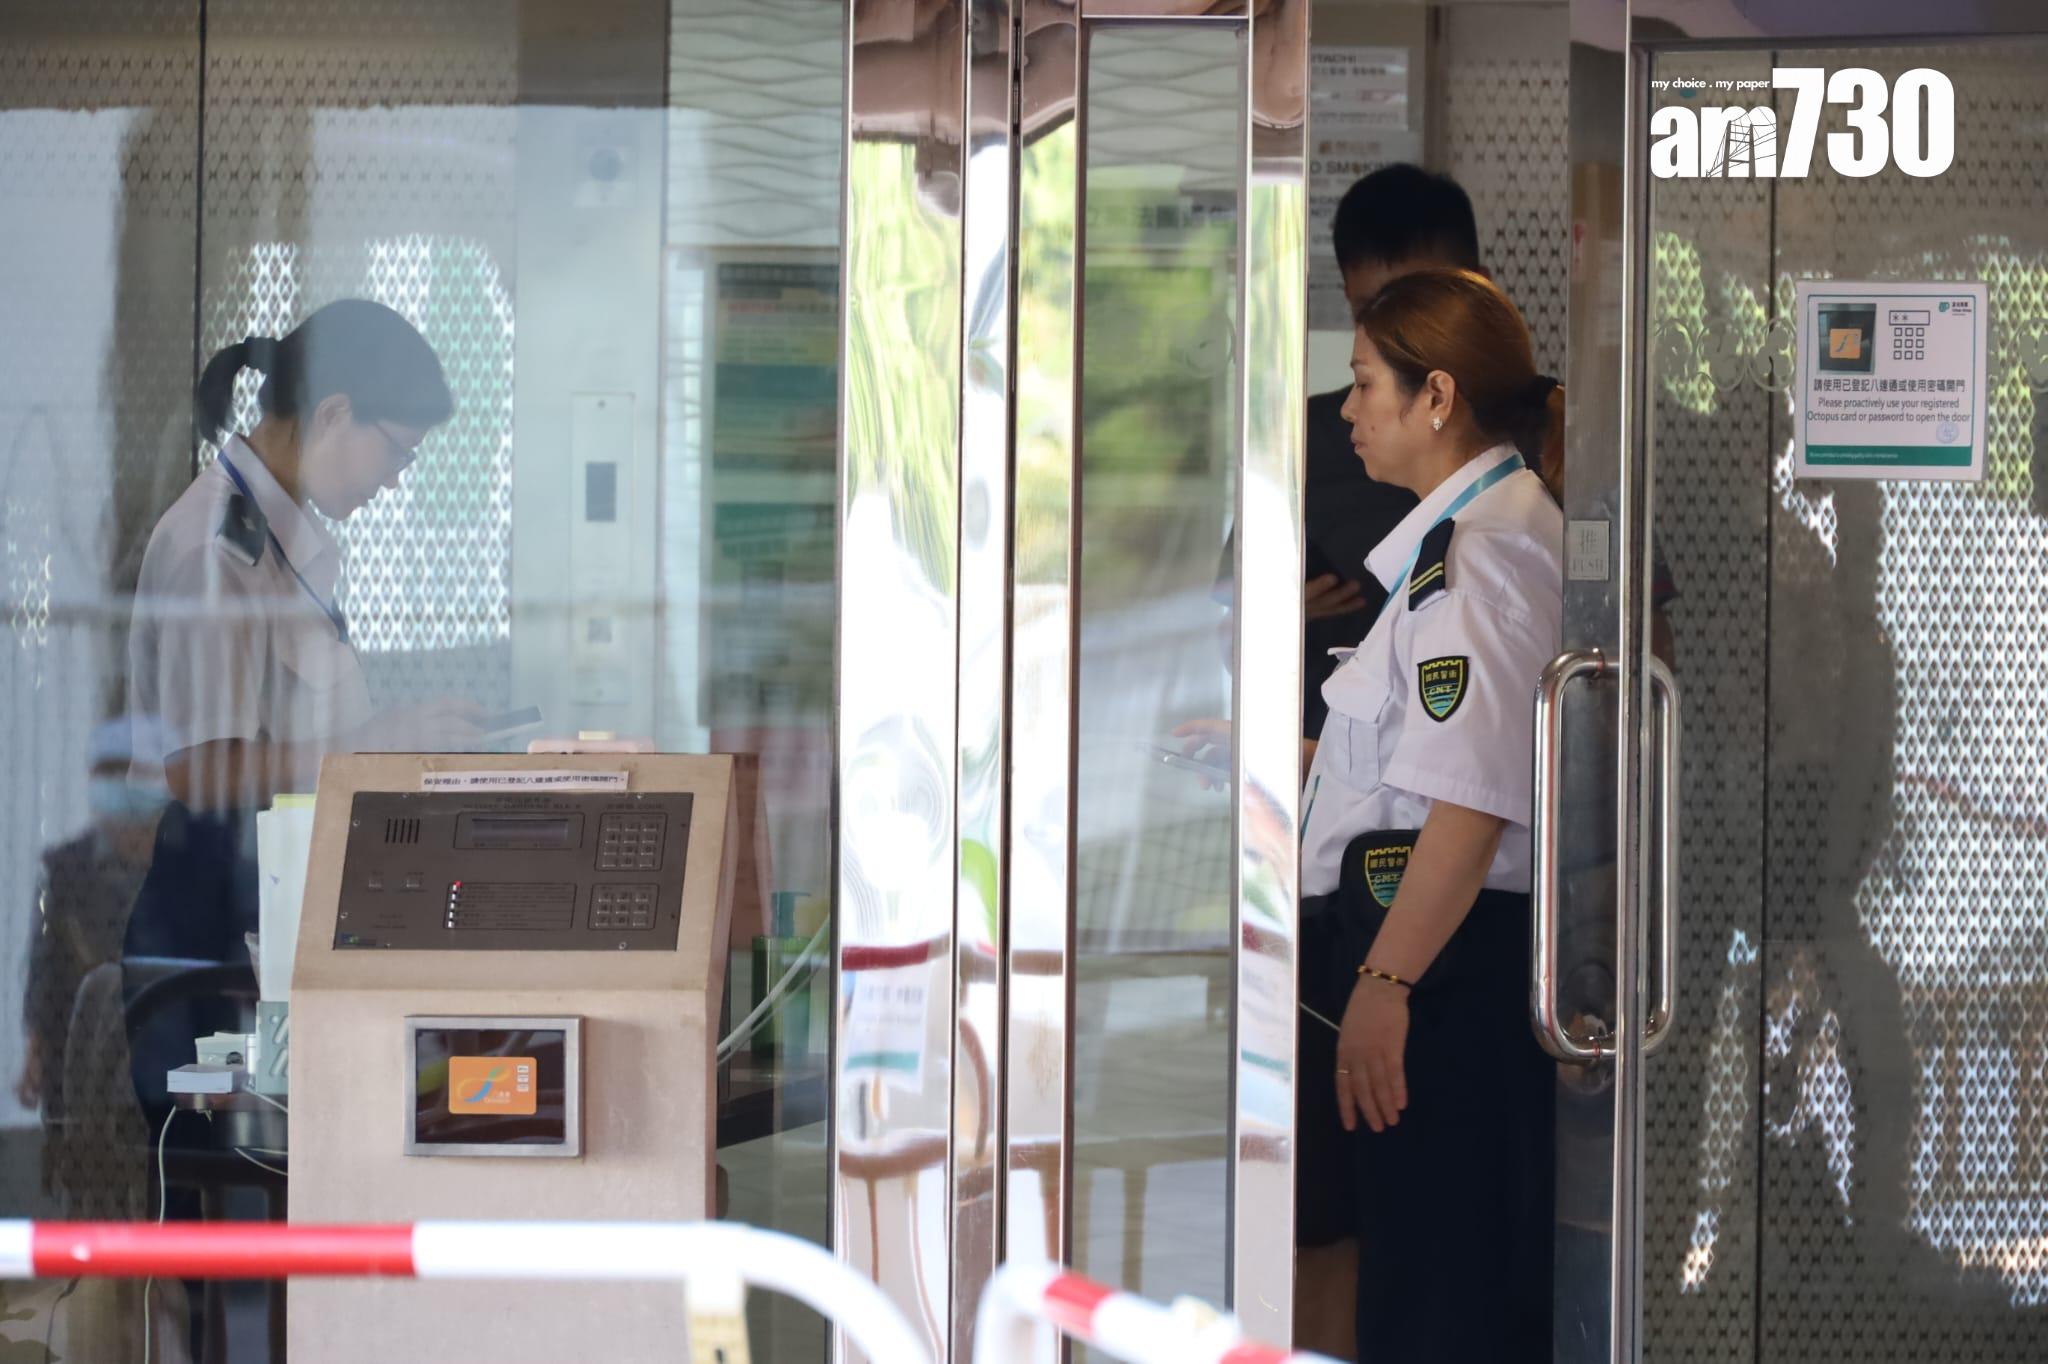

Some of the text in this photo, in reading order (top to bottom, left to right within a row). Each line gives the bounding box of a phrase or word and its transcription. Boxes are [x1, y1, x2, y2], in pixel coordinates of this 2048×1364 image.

[1310, 160, 1322, 174] O
[1818, 397, 1960, 411] Please proactively use your registered
[1807, 411, 1971, 423] Octopus card or password to open the door
